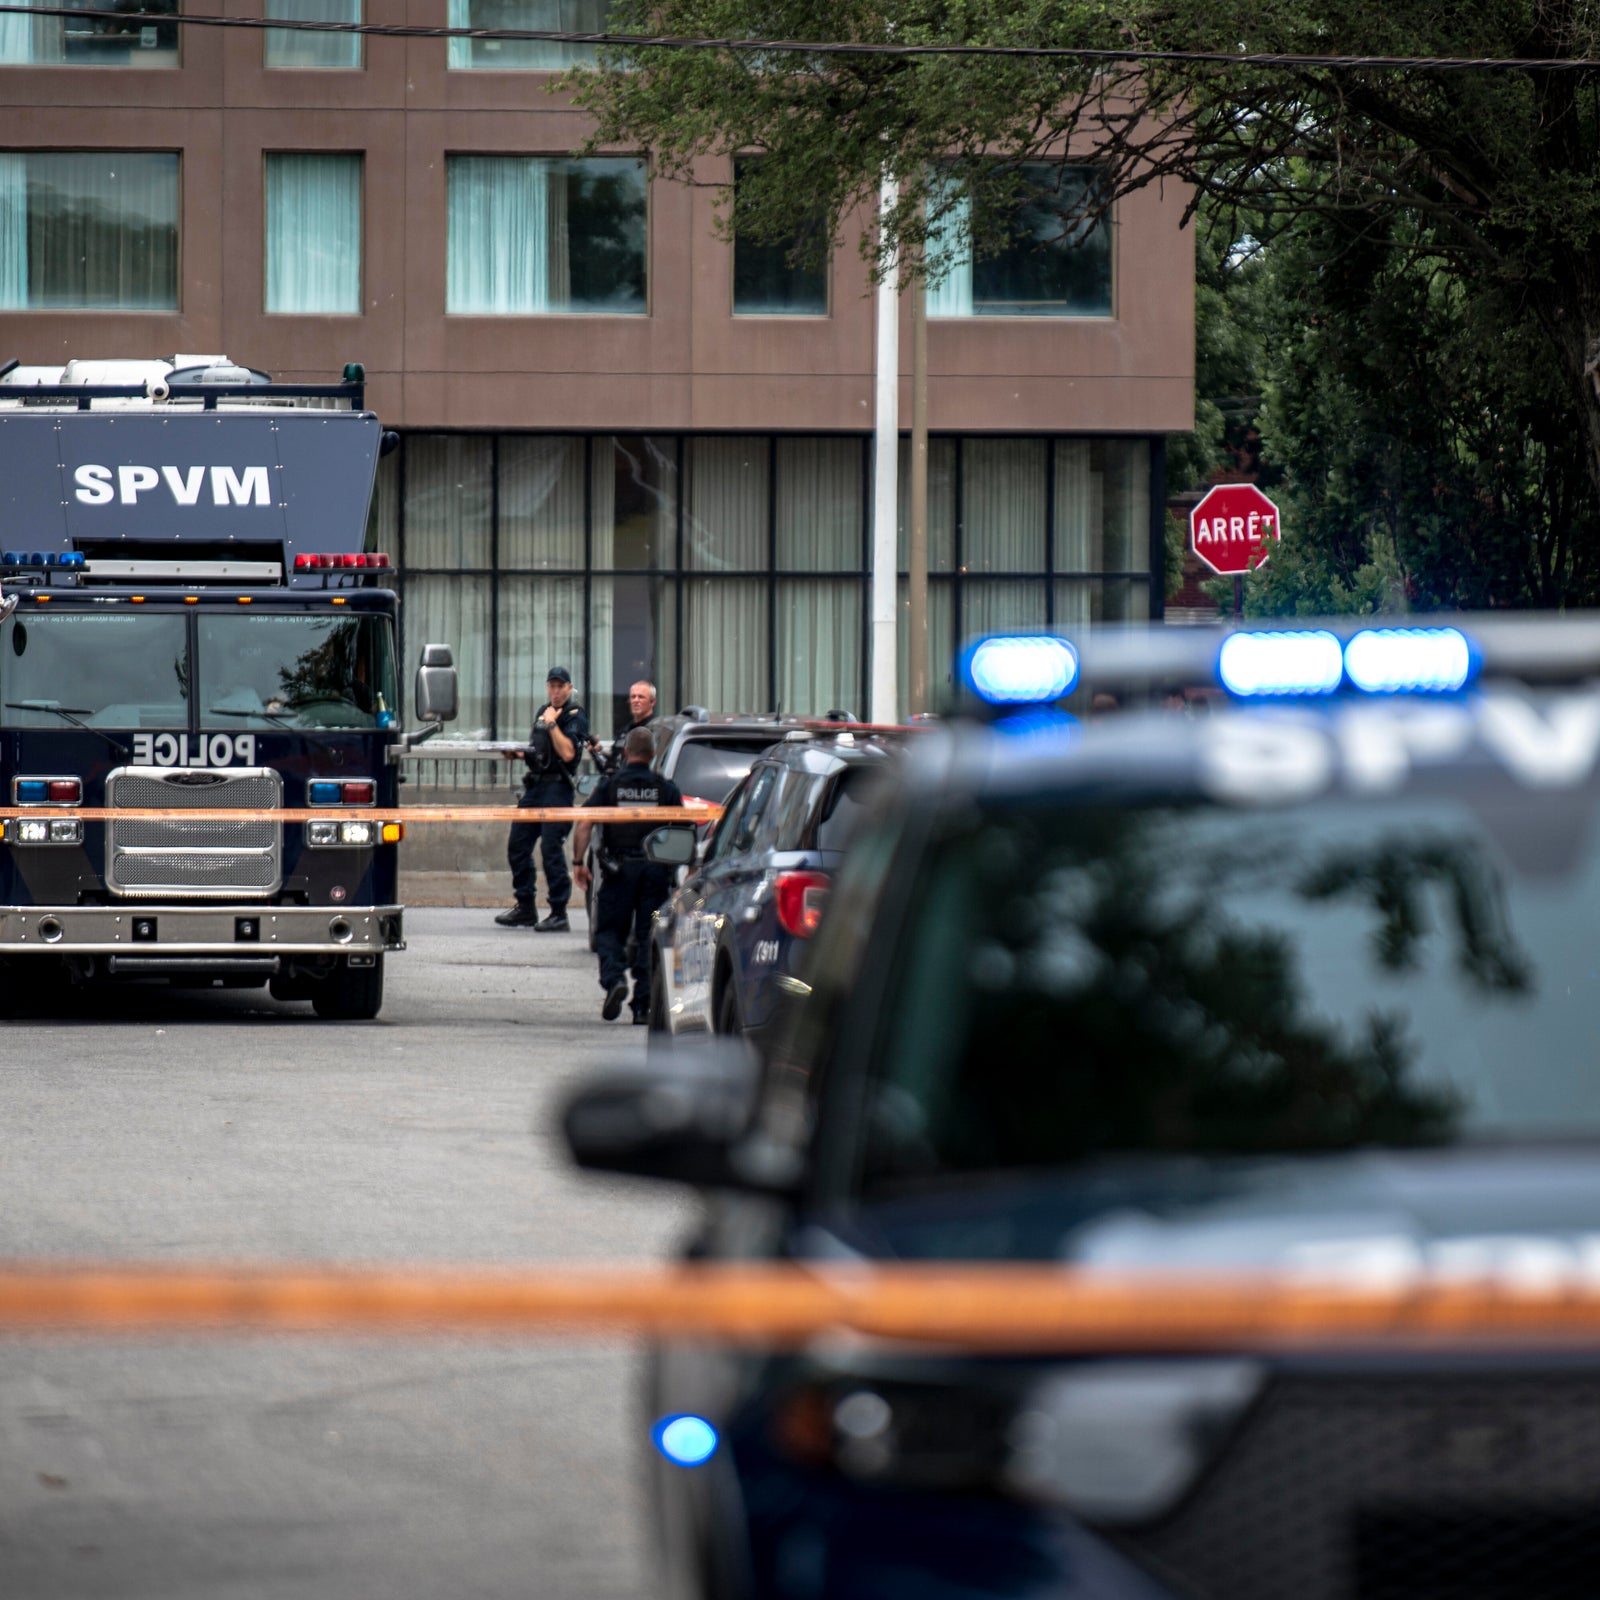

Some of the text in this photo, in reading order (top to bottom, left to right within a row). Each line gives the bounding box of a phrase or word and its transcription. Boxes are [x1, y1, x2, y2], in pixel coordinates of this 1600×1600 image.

[74, 464, 271, 506] SPVM
[1197, 510, 1274, 543] ARRÊT
[617, 787, 660, 800] POLICE
